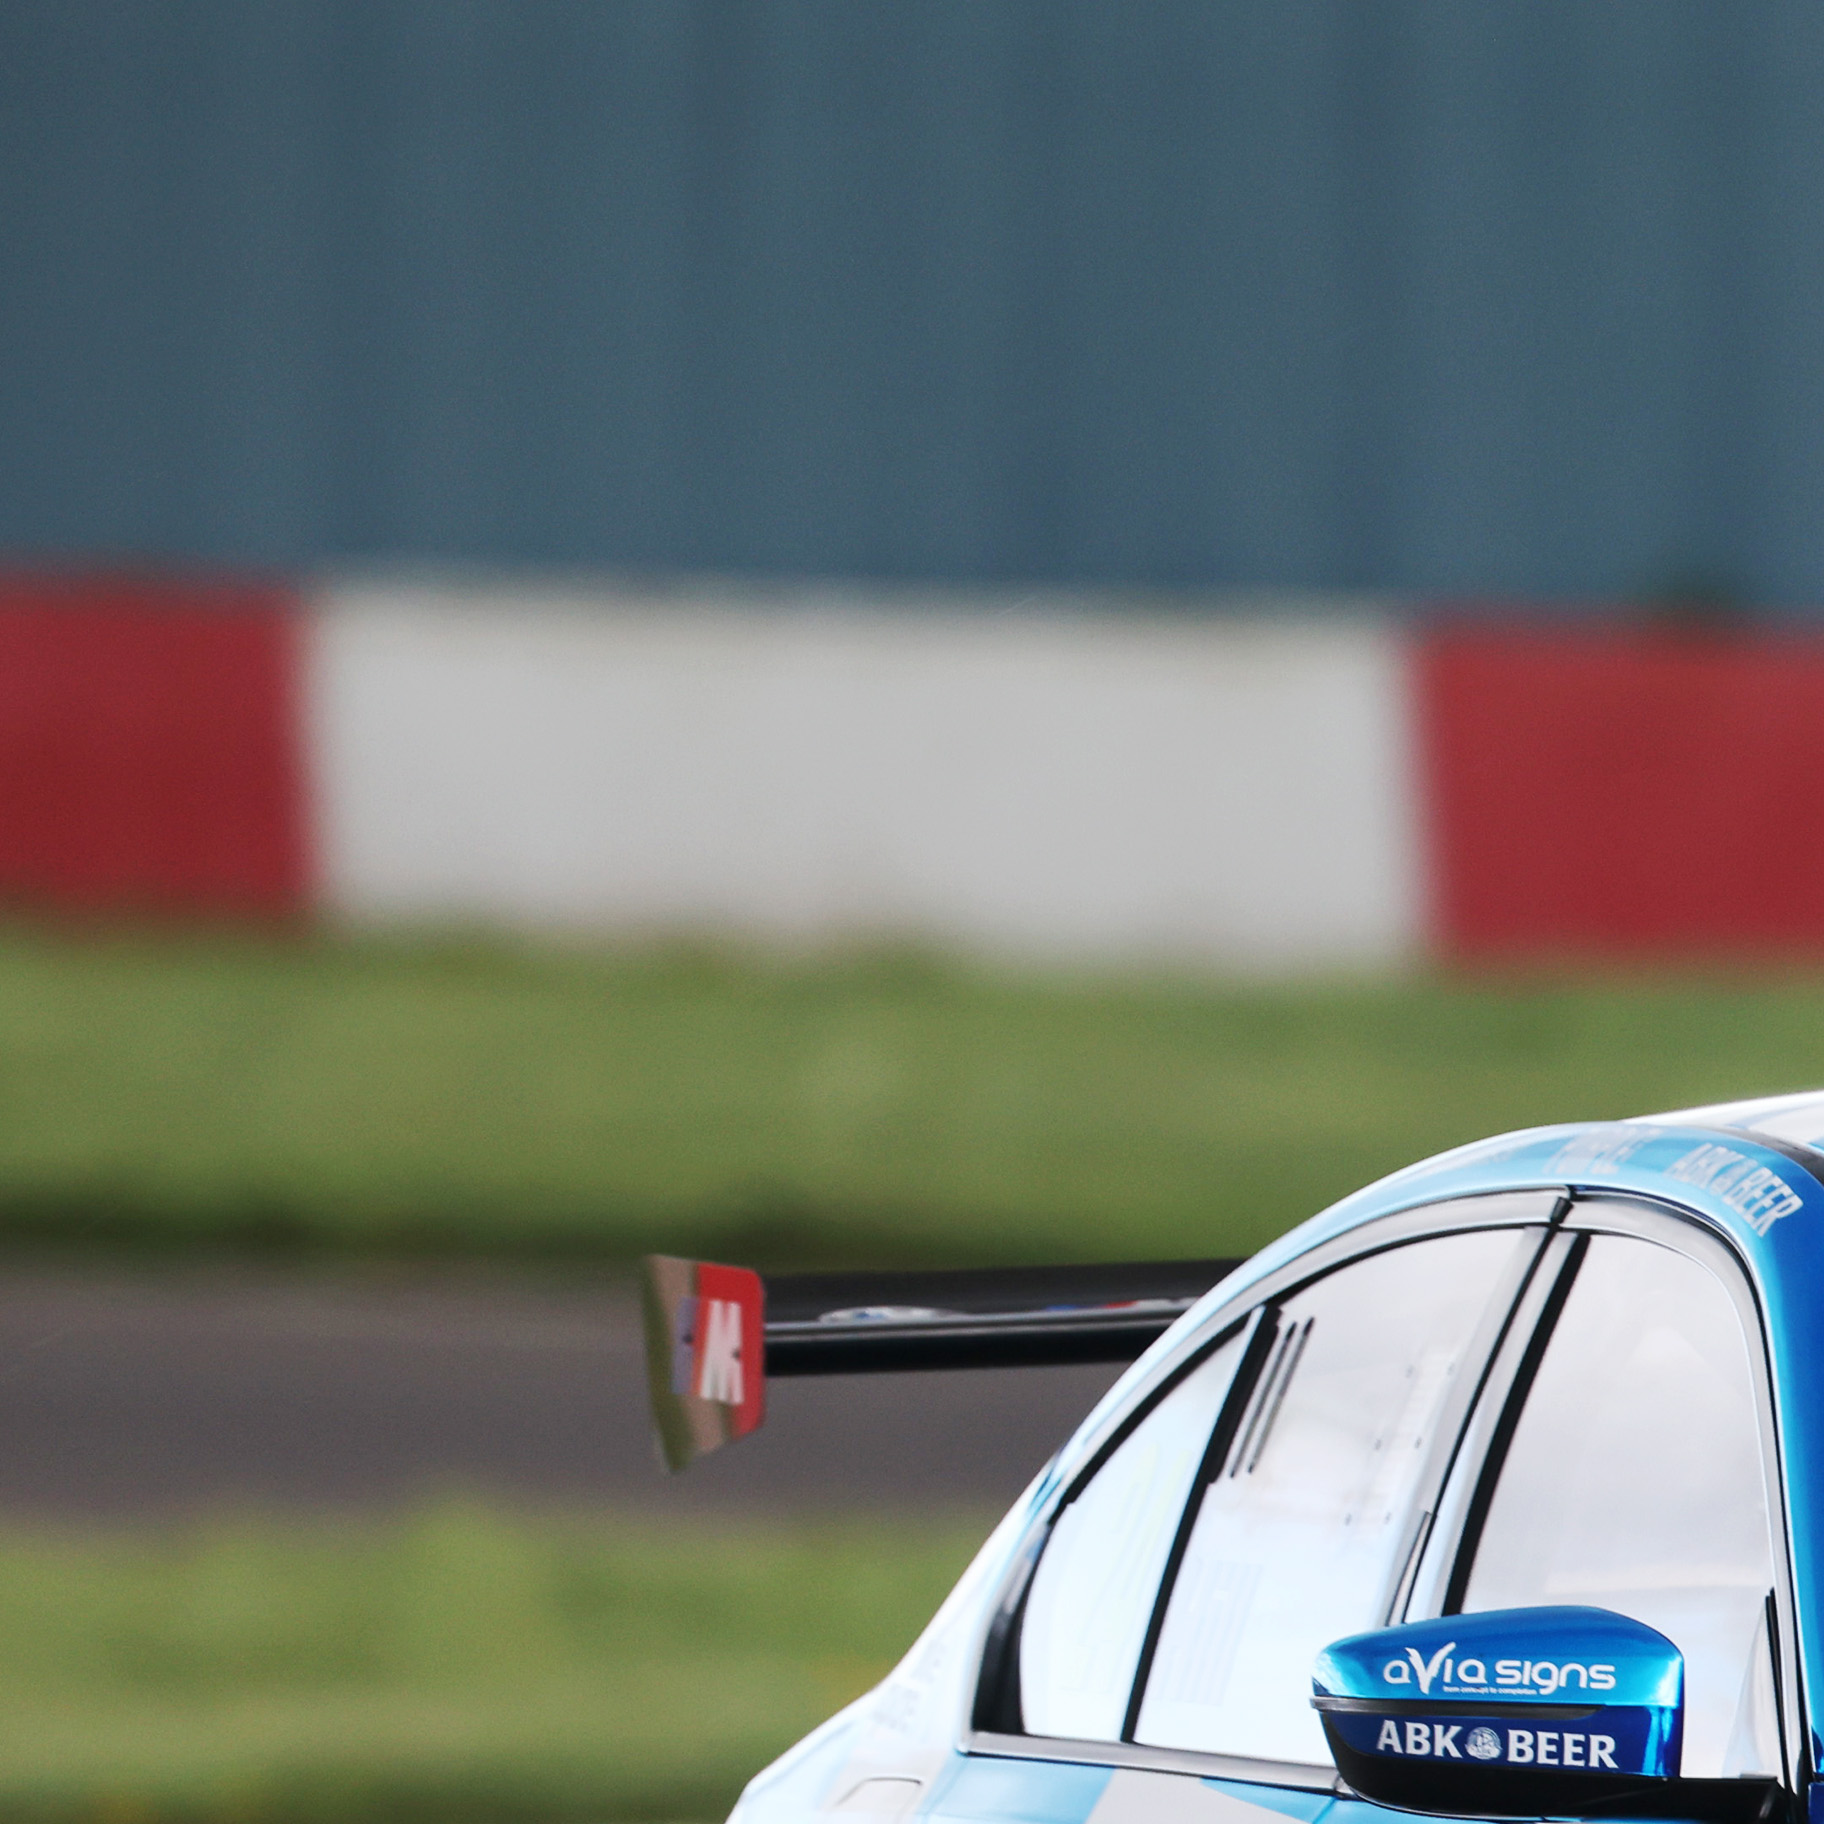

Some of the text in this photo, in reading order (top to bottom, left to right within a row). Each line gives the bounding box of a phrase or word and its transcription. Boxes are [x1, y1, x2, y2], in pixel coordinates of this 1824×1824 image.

[1720, 1160, 1803, 1237] BEER
[1494, 1659, 1617, 1696] signs
[1375, 1720, 1620, 1769] ABK BEER
